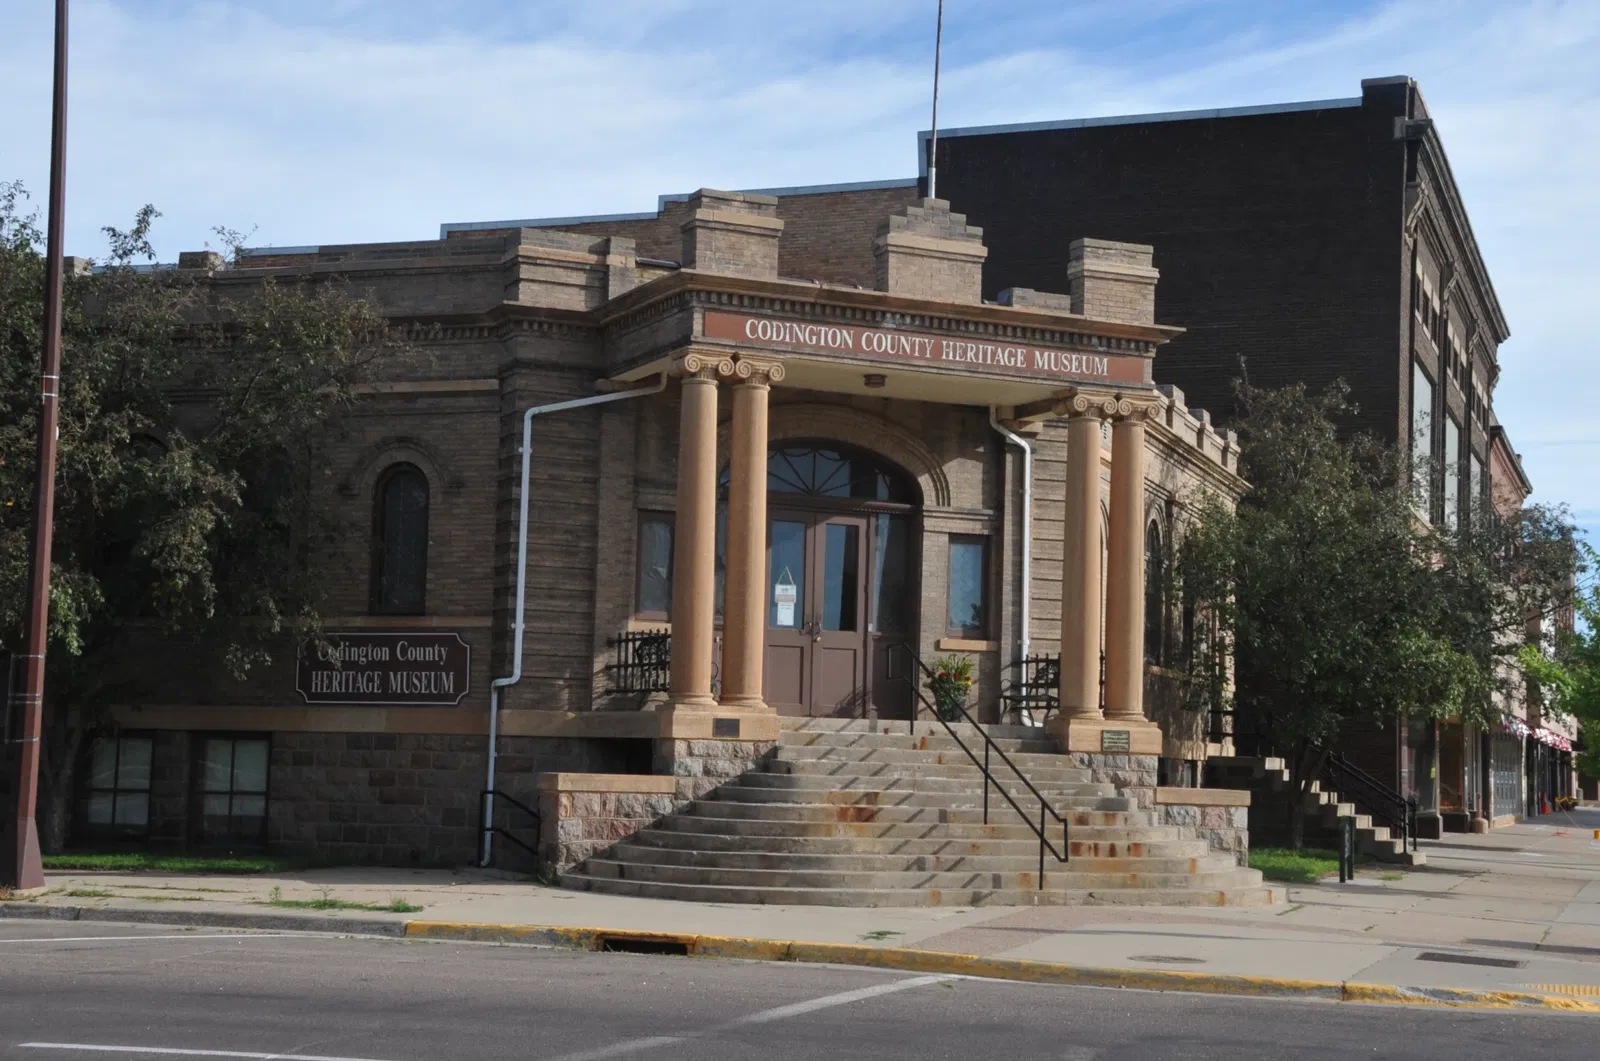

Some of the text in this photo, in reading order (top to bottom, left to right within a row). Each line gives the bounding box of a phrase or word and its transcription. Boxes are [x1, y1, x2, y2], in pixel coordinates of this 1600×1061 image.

[745, 319, 1109, 376] CODINGTON COUNTY HERITAGE MUSEUM
[318, 640, 449, 665] Cdington County
[311, 671, 455, 694] HERITAGE MUSEUM
